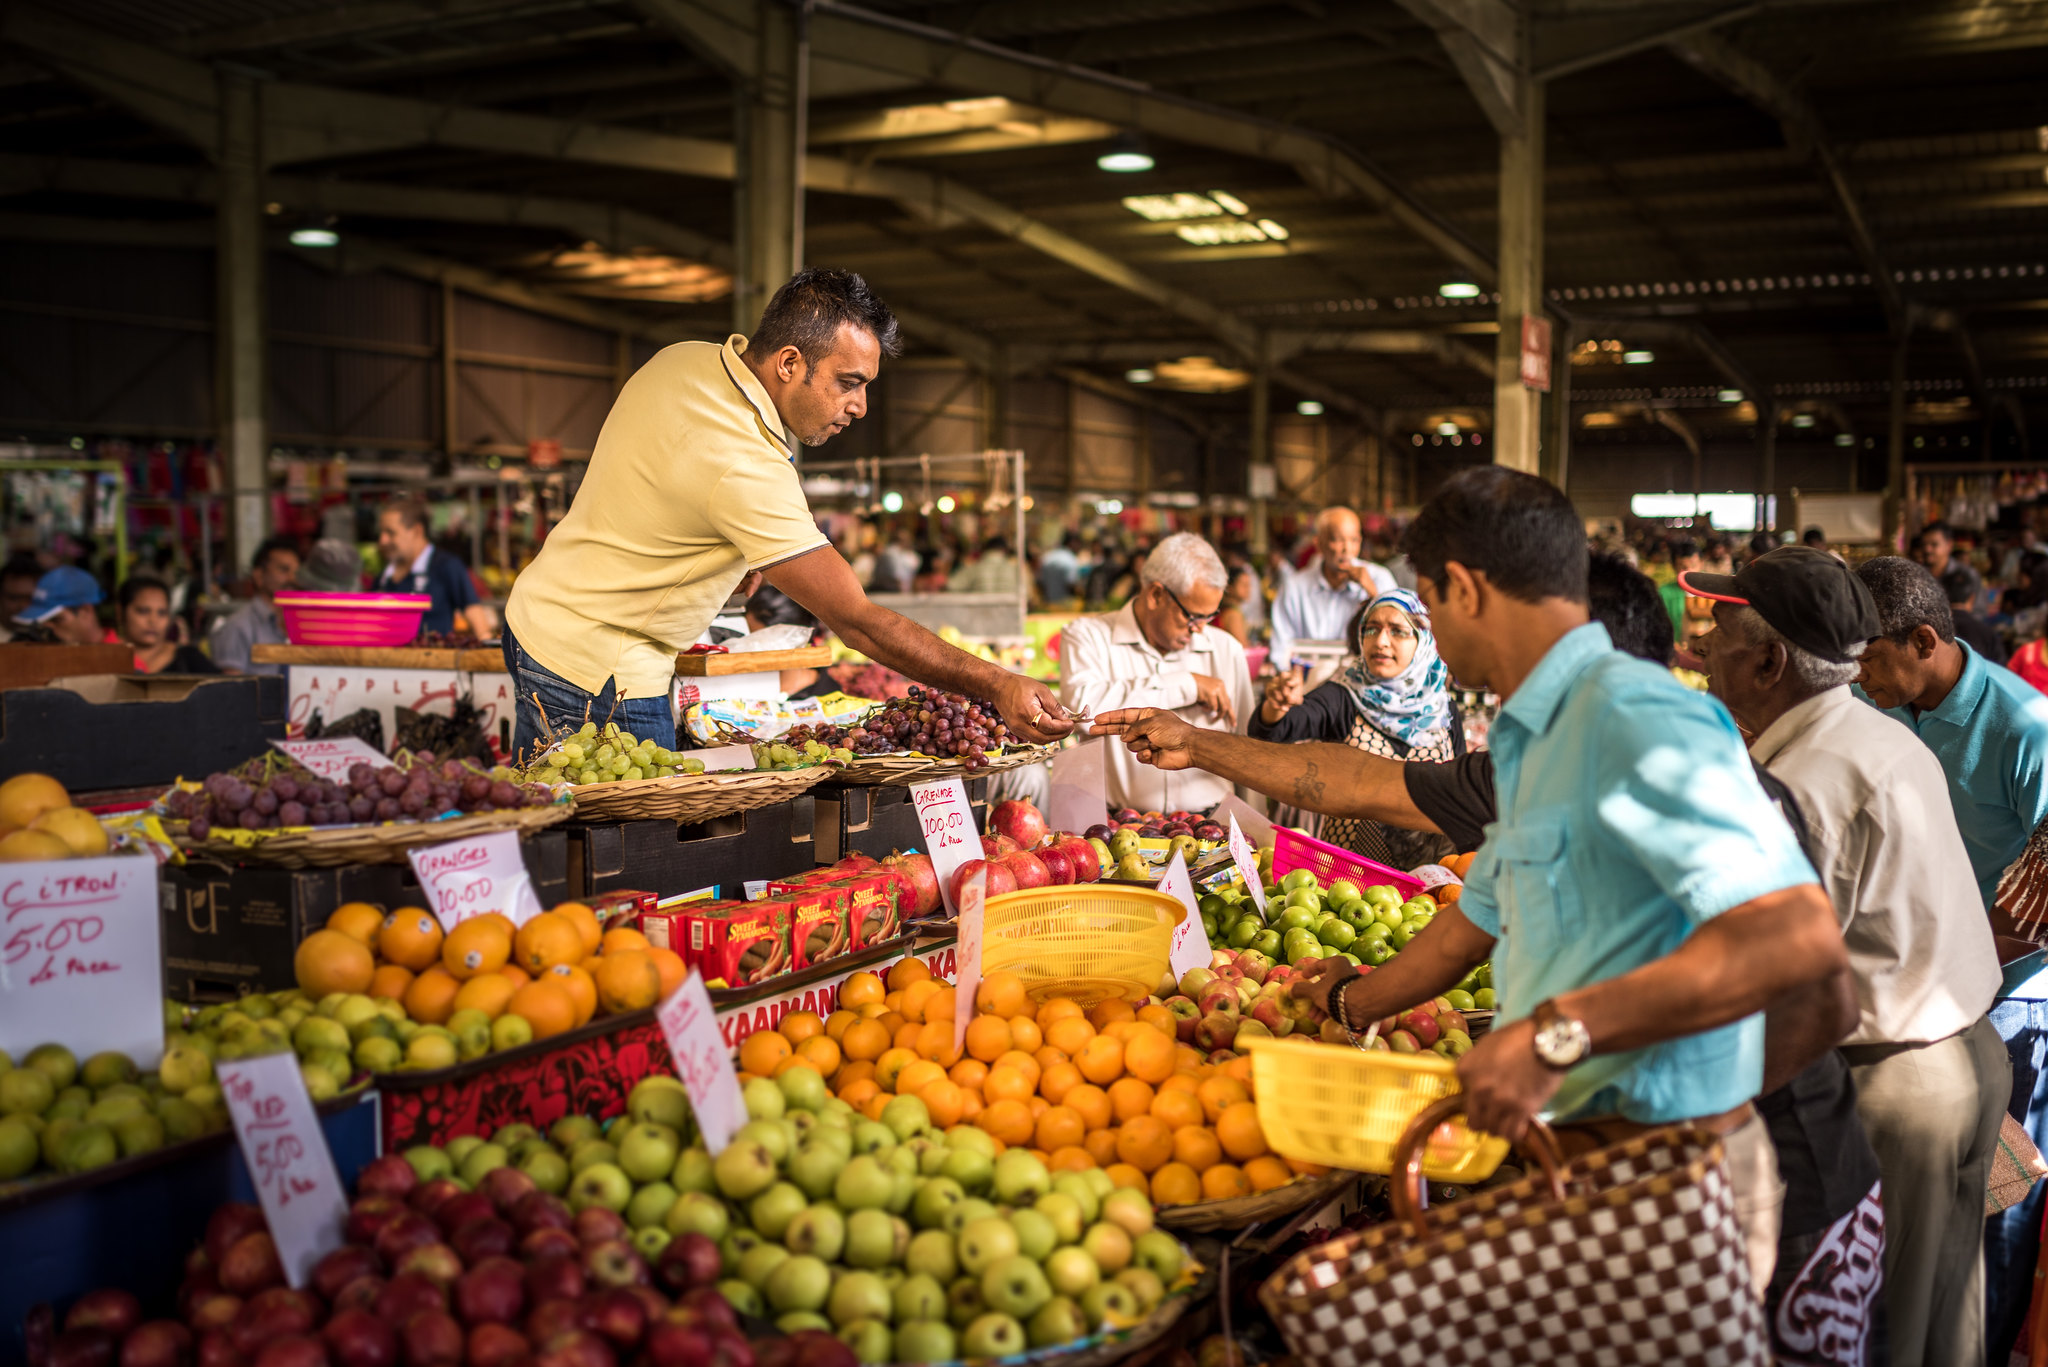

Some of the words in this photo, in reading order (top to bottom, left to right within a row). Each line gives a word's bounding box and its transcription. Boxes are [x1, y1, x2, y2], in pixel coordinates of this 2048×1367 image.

[915, 787, 953, 805] GRENADE
[925, 812, 963, 838] 100.00
[438, 877, 492, 914] 10.00
[4, 915, 104, 965] 5.00
